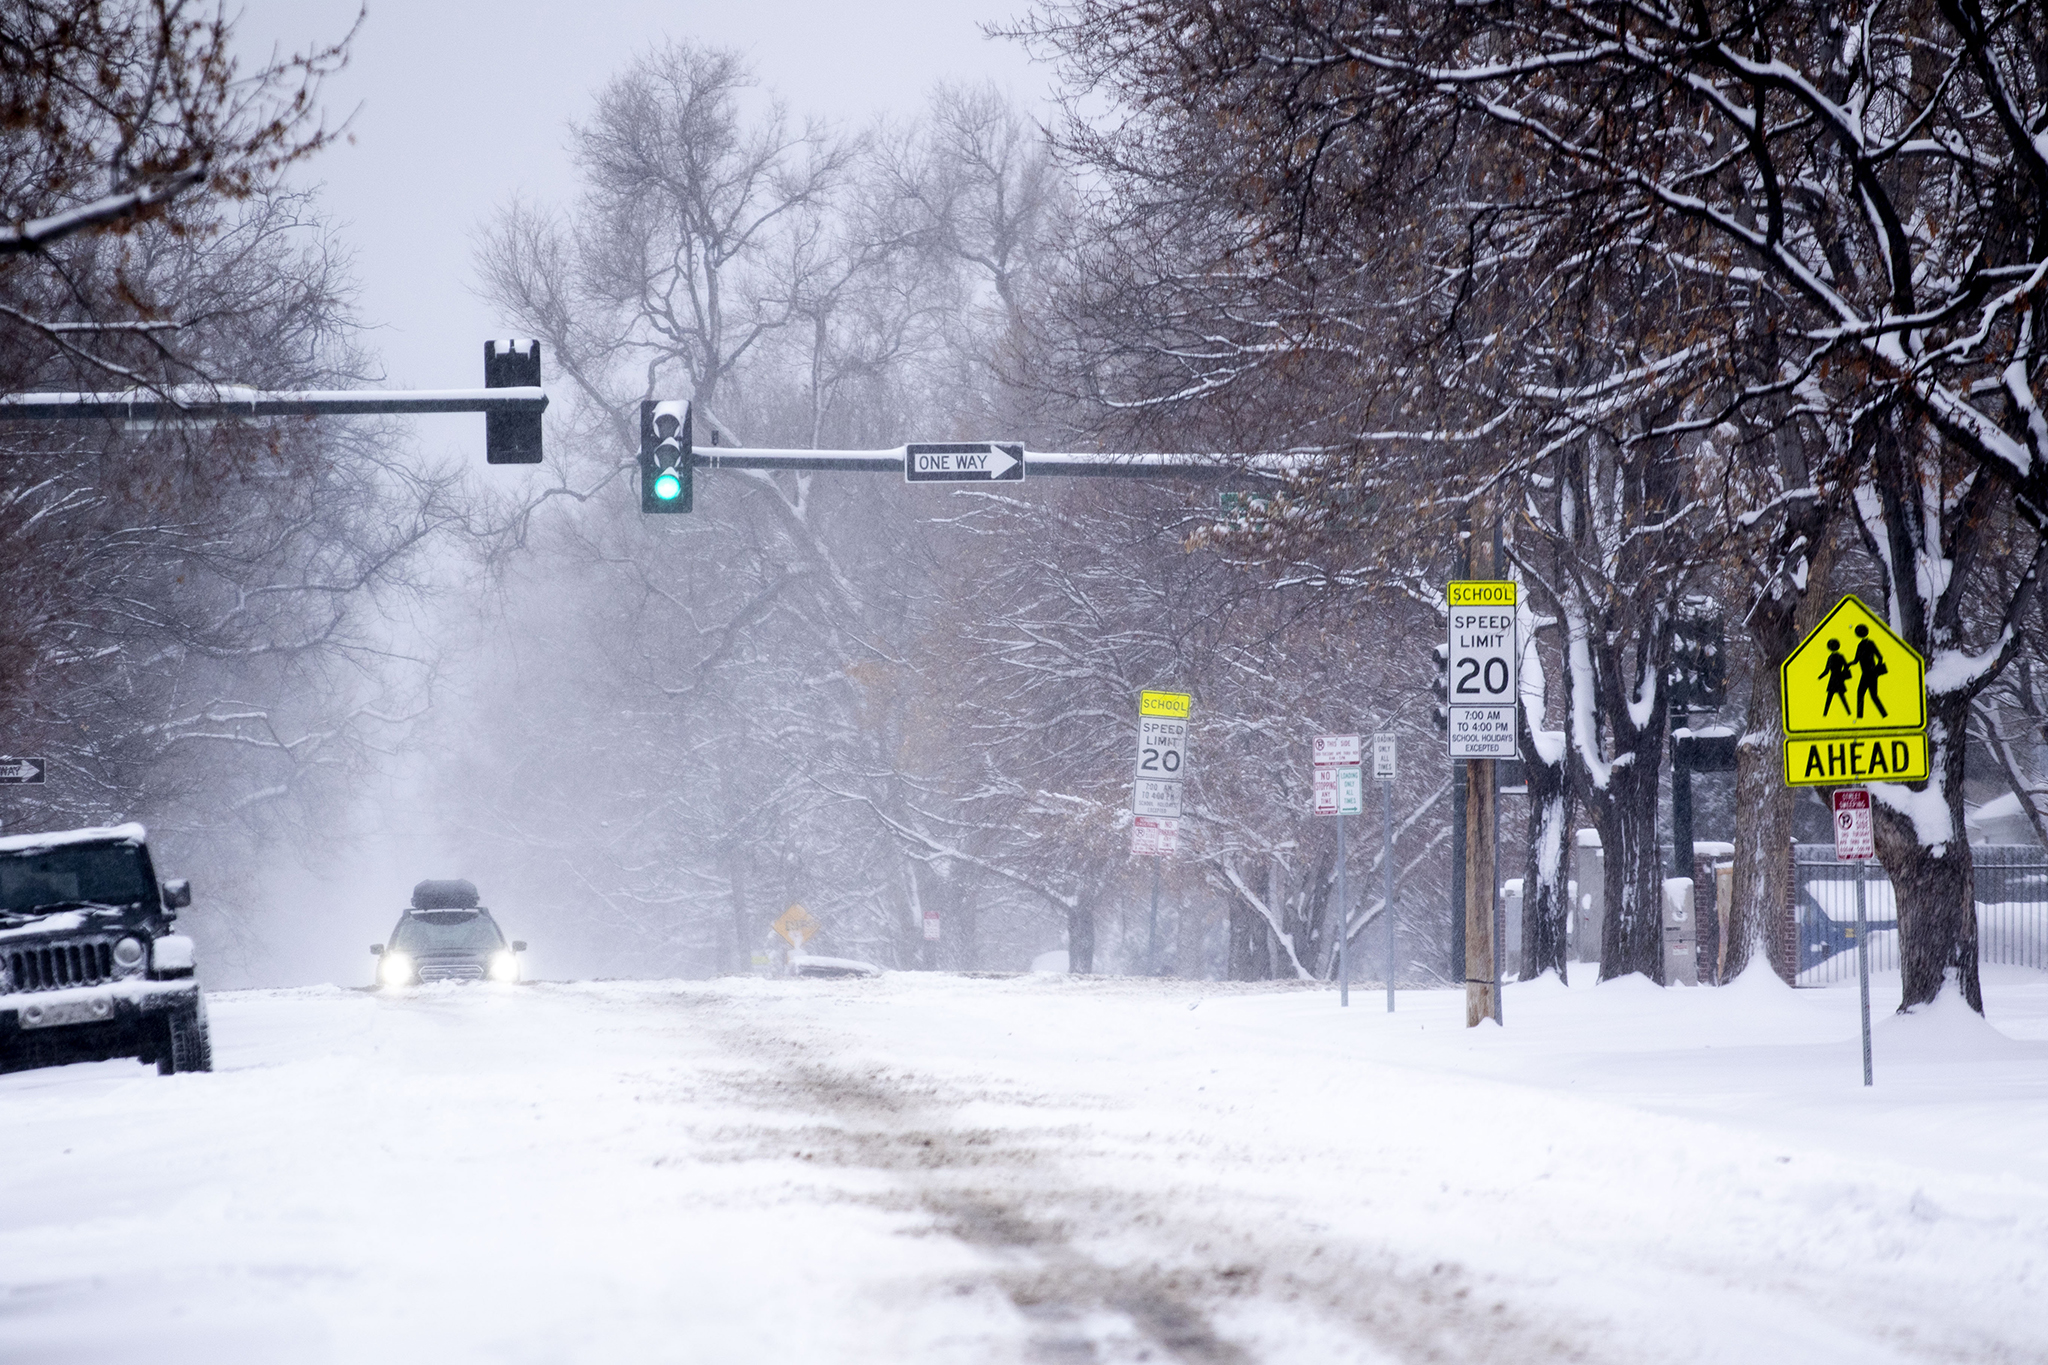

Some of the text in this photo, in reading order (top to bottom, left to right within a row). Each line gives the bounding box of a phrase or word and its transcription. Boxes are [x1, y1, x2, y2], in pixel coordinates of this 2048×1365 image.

[919, 455, 988, 470] ONE WAY
[1453, 587, 1513, 601] SCHOOL
[1454, 616, 1511, 629] SPEED
[1460, 635, 1504, 648] LIMIT
[1456, 657, 1509, 694] 20
[1143, 698, 1187, 712] SCHOOL
[1464, 710, 1501, 720] 7:00 AM
[1143, 722, 1184, 735] SPEED
[1457, 722, 1508, 732] TO 4:00 PM
[1146, 735, 1178, 747] LIMIT
[1452, 734, 1513, 742] SCHOOL HOLIDAYS
[1465, 744, 1500, 752] EXCEPTED
[1141, 748, 1180, 772] 20
[1804, 740, 1910, 778] AHEAD
[0, 766, 20, 777] WAY
[1320, 771, 1331, 780] NO
